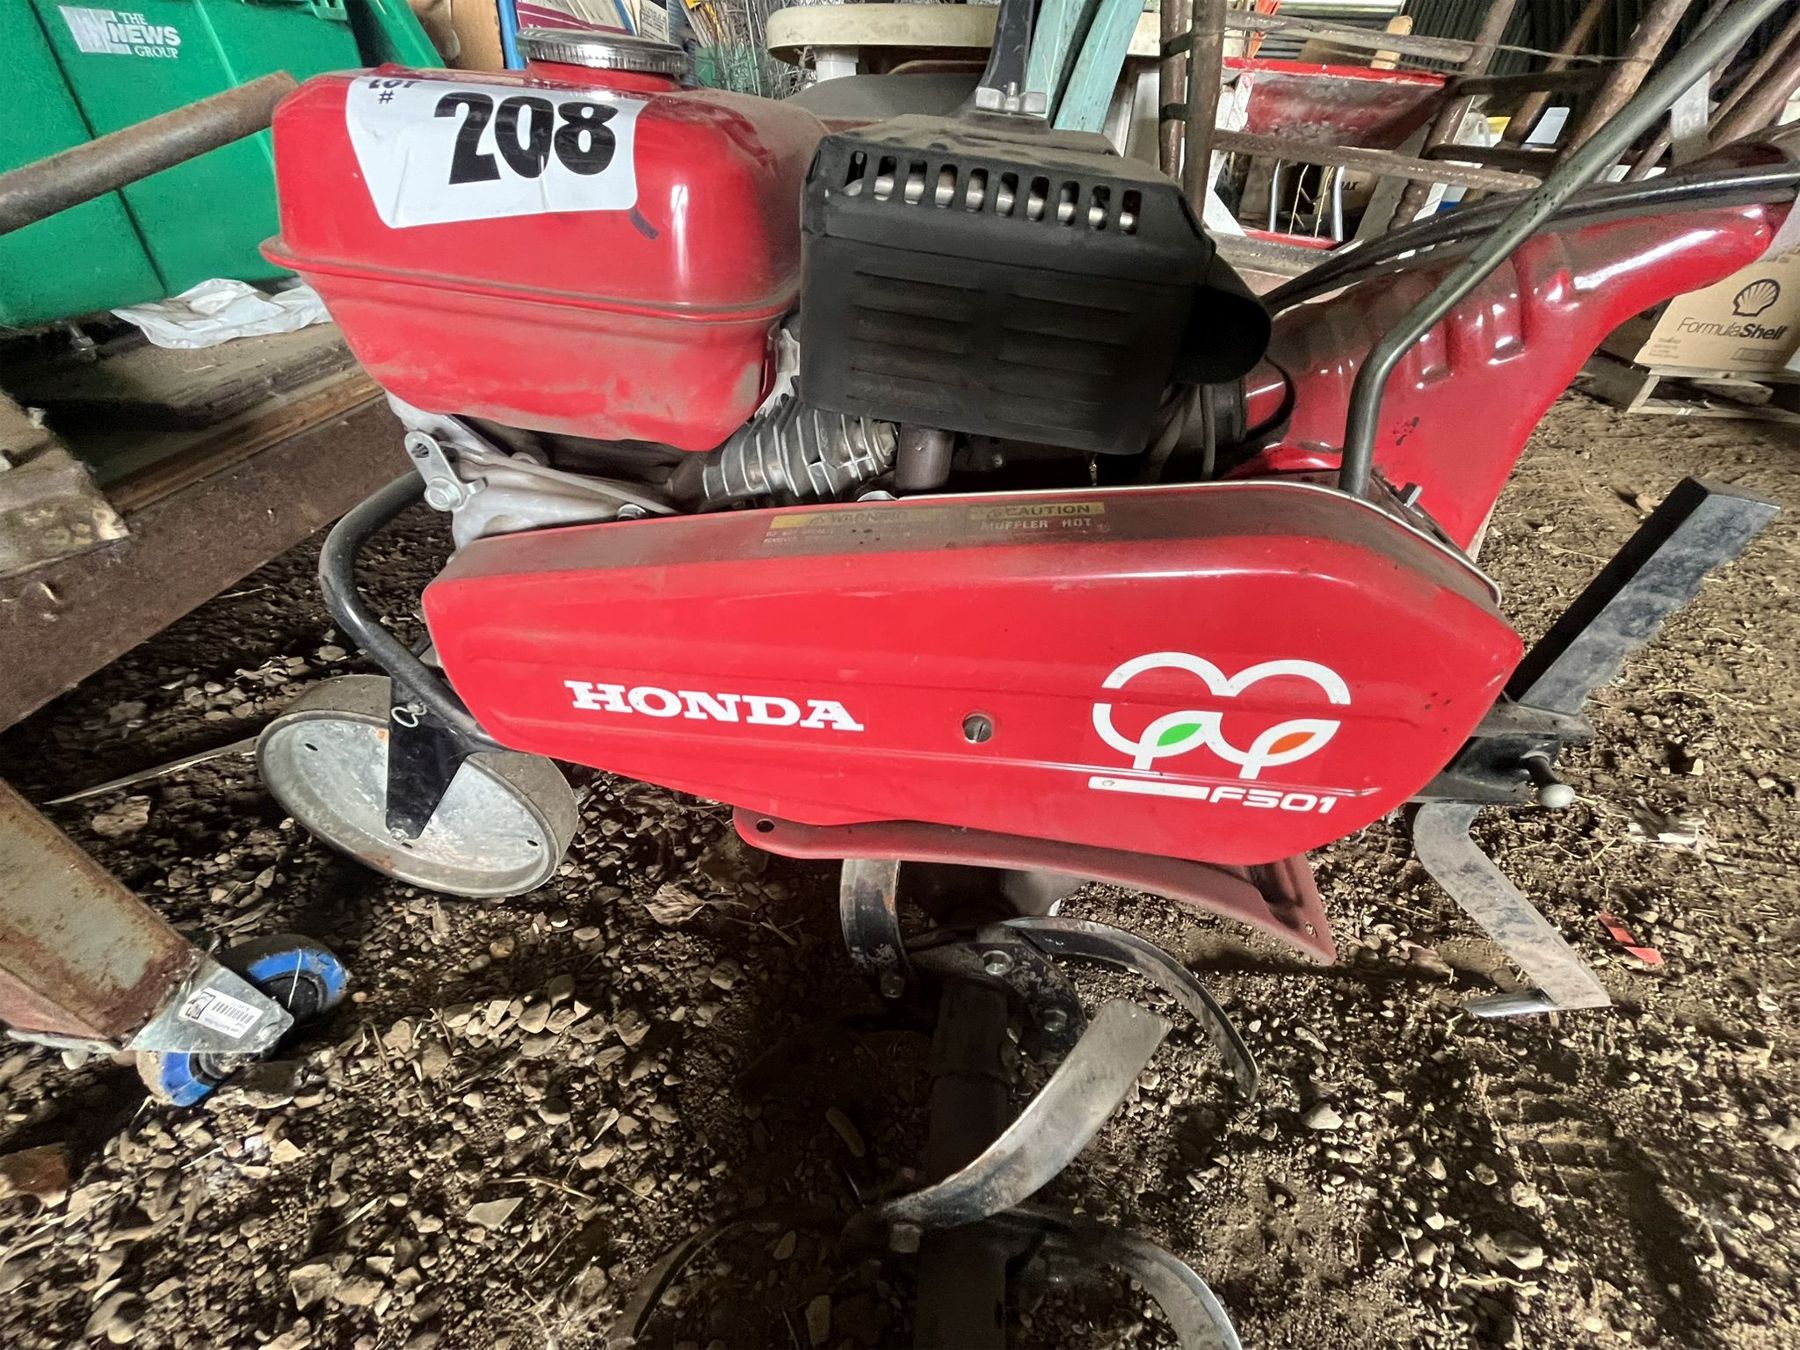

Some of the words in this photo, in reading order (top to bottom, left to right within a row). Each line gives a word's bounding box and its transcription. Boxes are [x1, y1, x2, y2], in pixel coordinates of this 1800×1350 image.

[118, 12, 148, 25] THE
[106, 22, 181, 46] NEWS
[134, 45, 178, 58] GROUP
[434, 93, 618, 185] 208
[1677, 317, 1787, 340] FormulaShell
[1006, 504, 1090, 517] CAUTION
[981, 519, 1048, 531] MUFFLER
[1062, 518, 1091, 528] HOT
[564, 680, 864, 731] HONDA
[1209, 786, 1337, 813] F501
